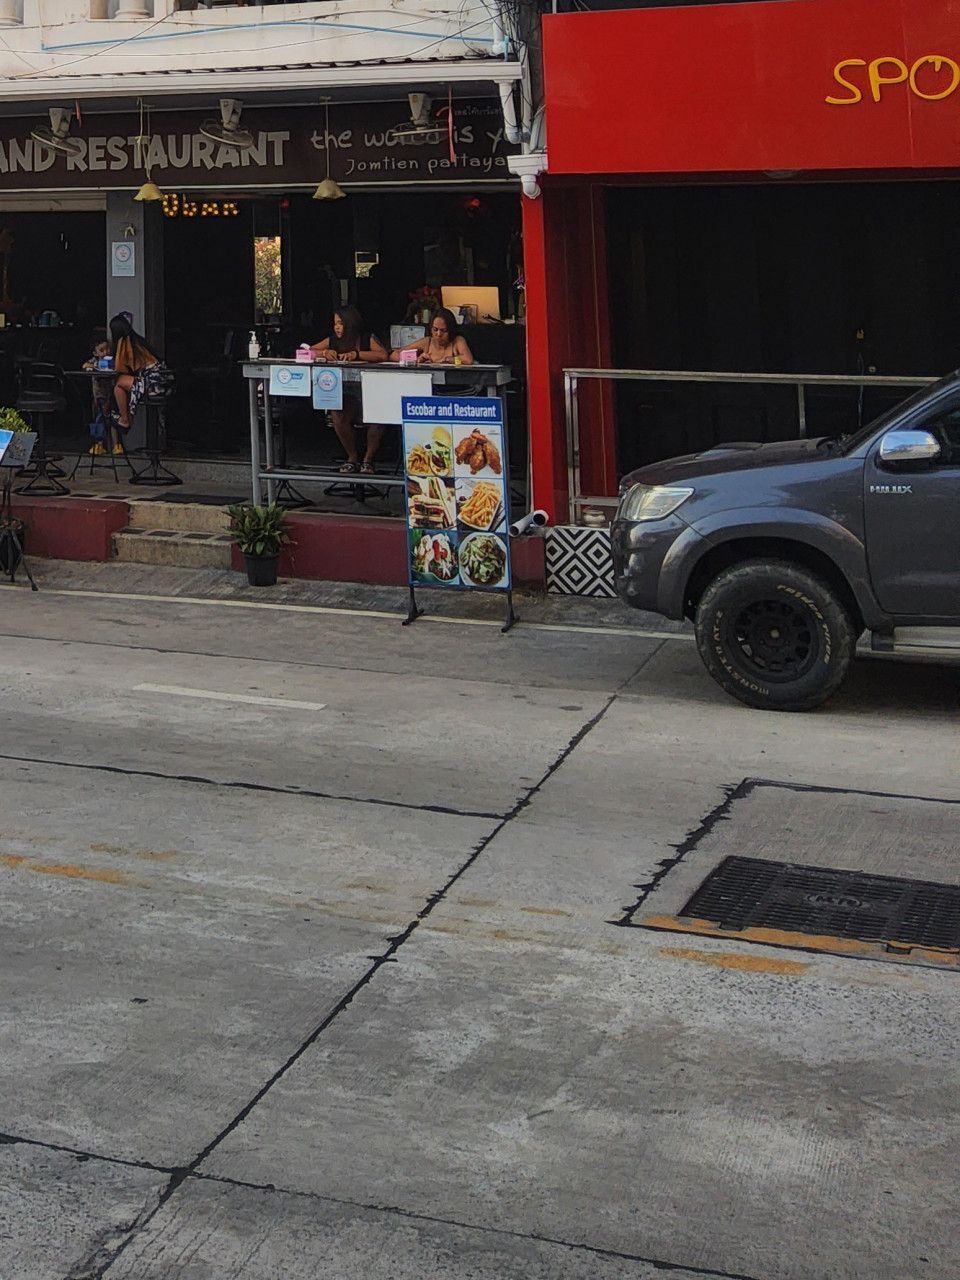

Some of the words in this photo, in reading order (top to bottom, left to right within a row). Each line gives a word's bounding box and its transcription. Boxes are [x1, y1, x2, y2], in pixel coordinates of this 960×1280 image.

[825, 55, 960, 104] SPO
[310, 129, 352, 149] the
[454, 126, 474, 144] is
[65, 131, 289, 171] RESTAURANT
[345, 156, 418, 175] Jomtien
[427, 153, 506, 174] pattaya
[406, 402, 436, 416] Escobar
[438, 403, 452, 416] and
[454, 403, 496, 417] Restaurant
